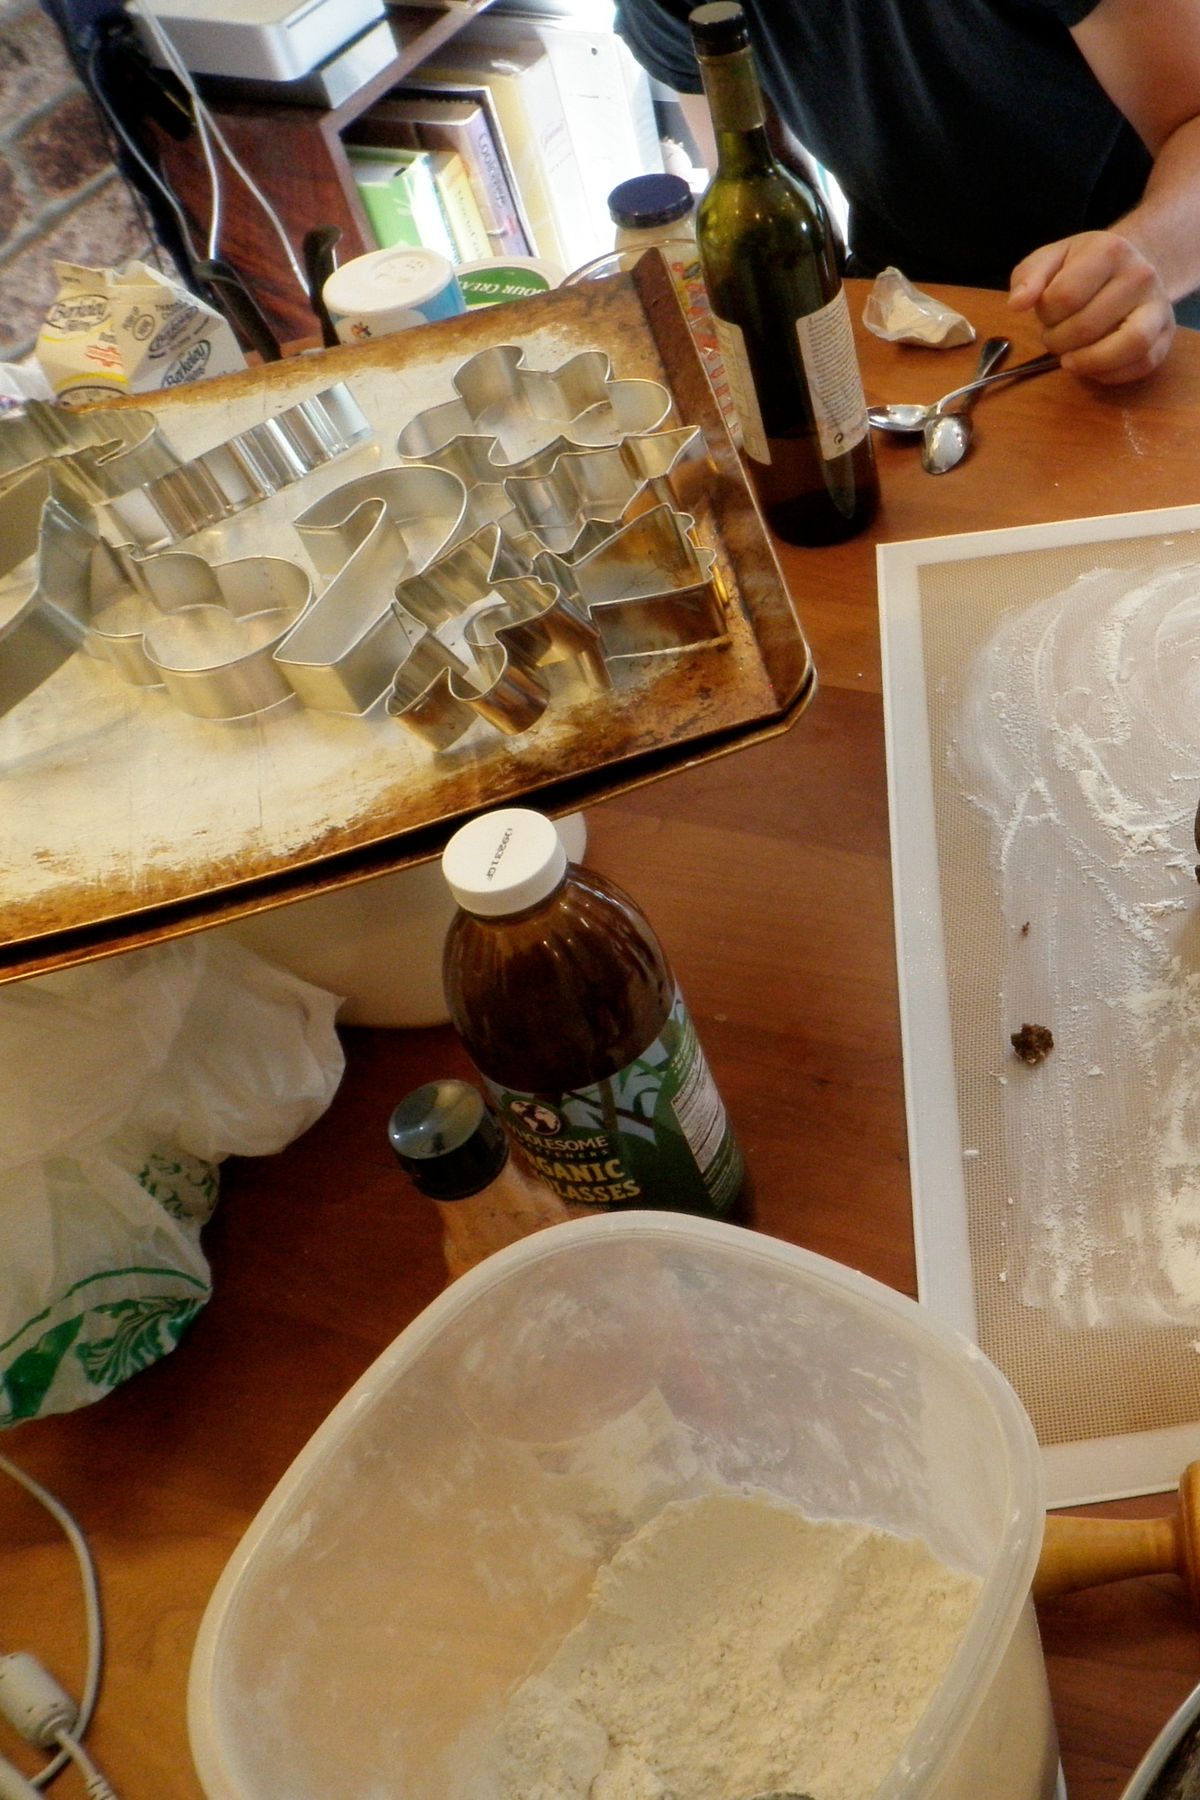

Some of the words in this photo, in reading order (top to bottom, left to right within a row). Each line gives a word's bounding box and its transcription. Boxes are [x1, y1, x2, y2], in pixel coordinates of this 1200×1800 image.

[461, 279, 500, 296] CREA
[530, 1157, 625, 1183] GANIC
[541, 1179, 641, 1203] OLASSES
